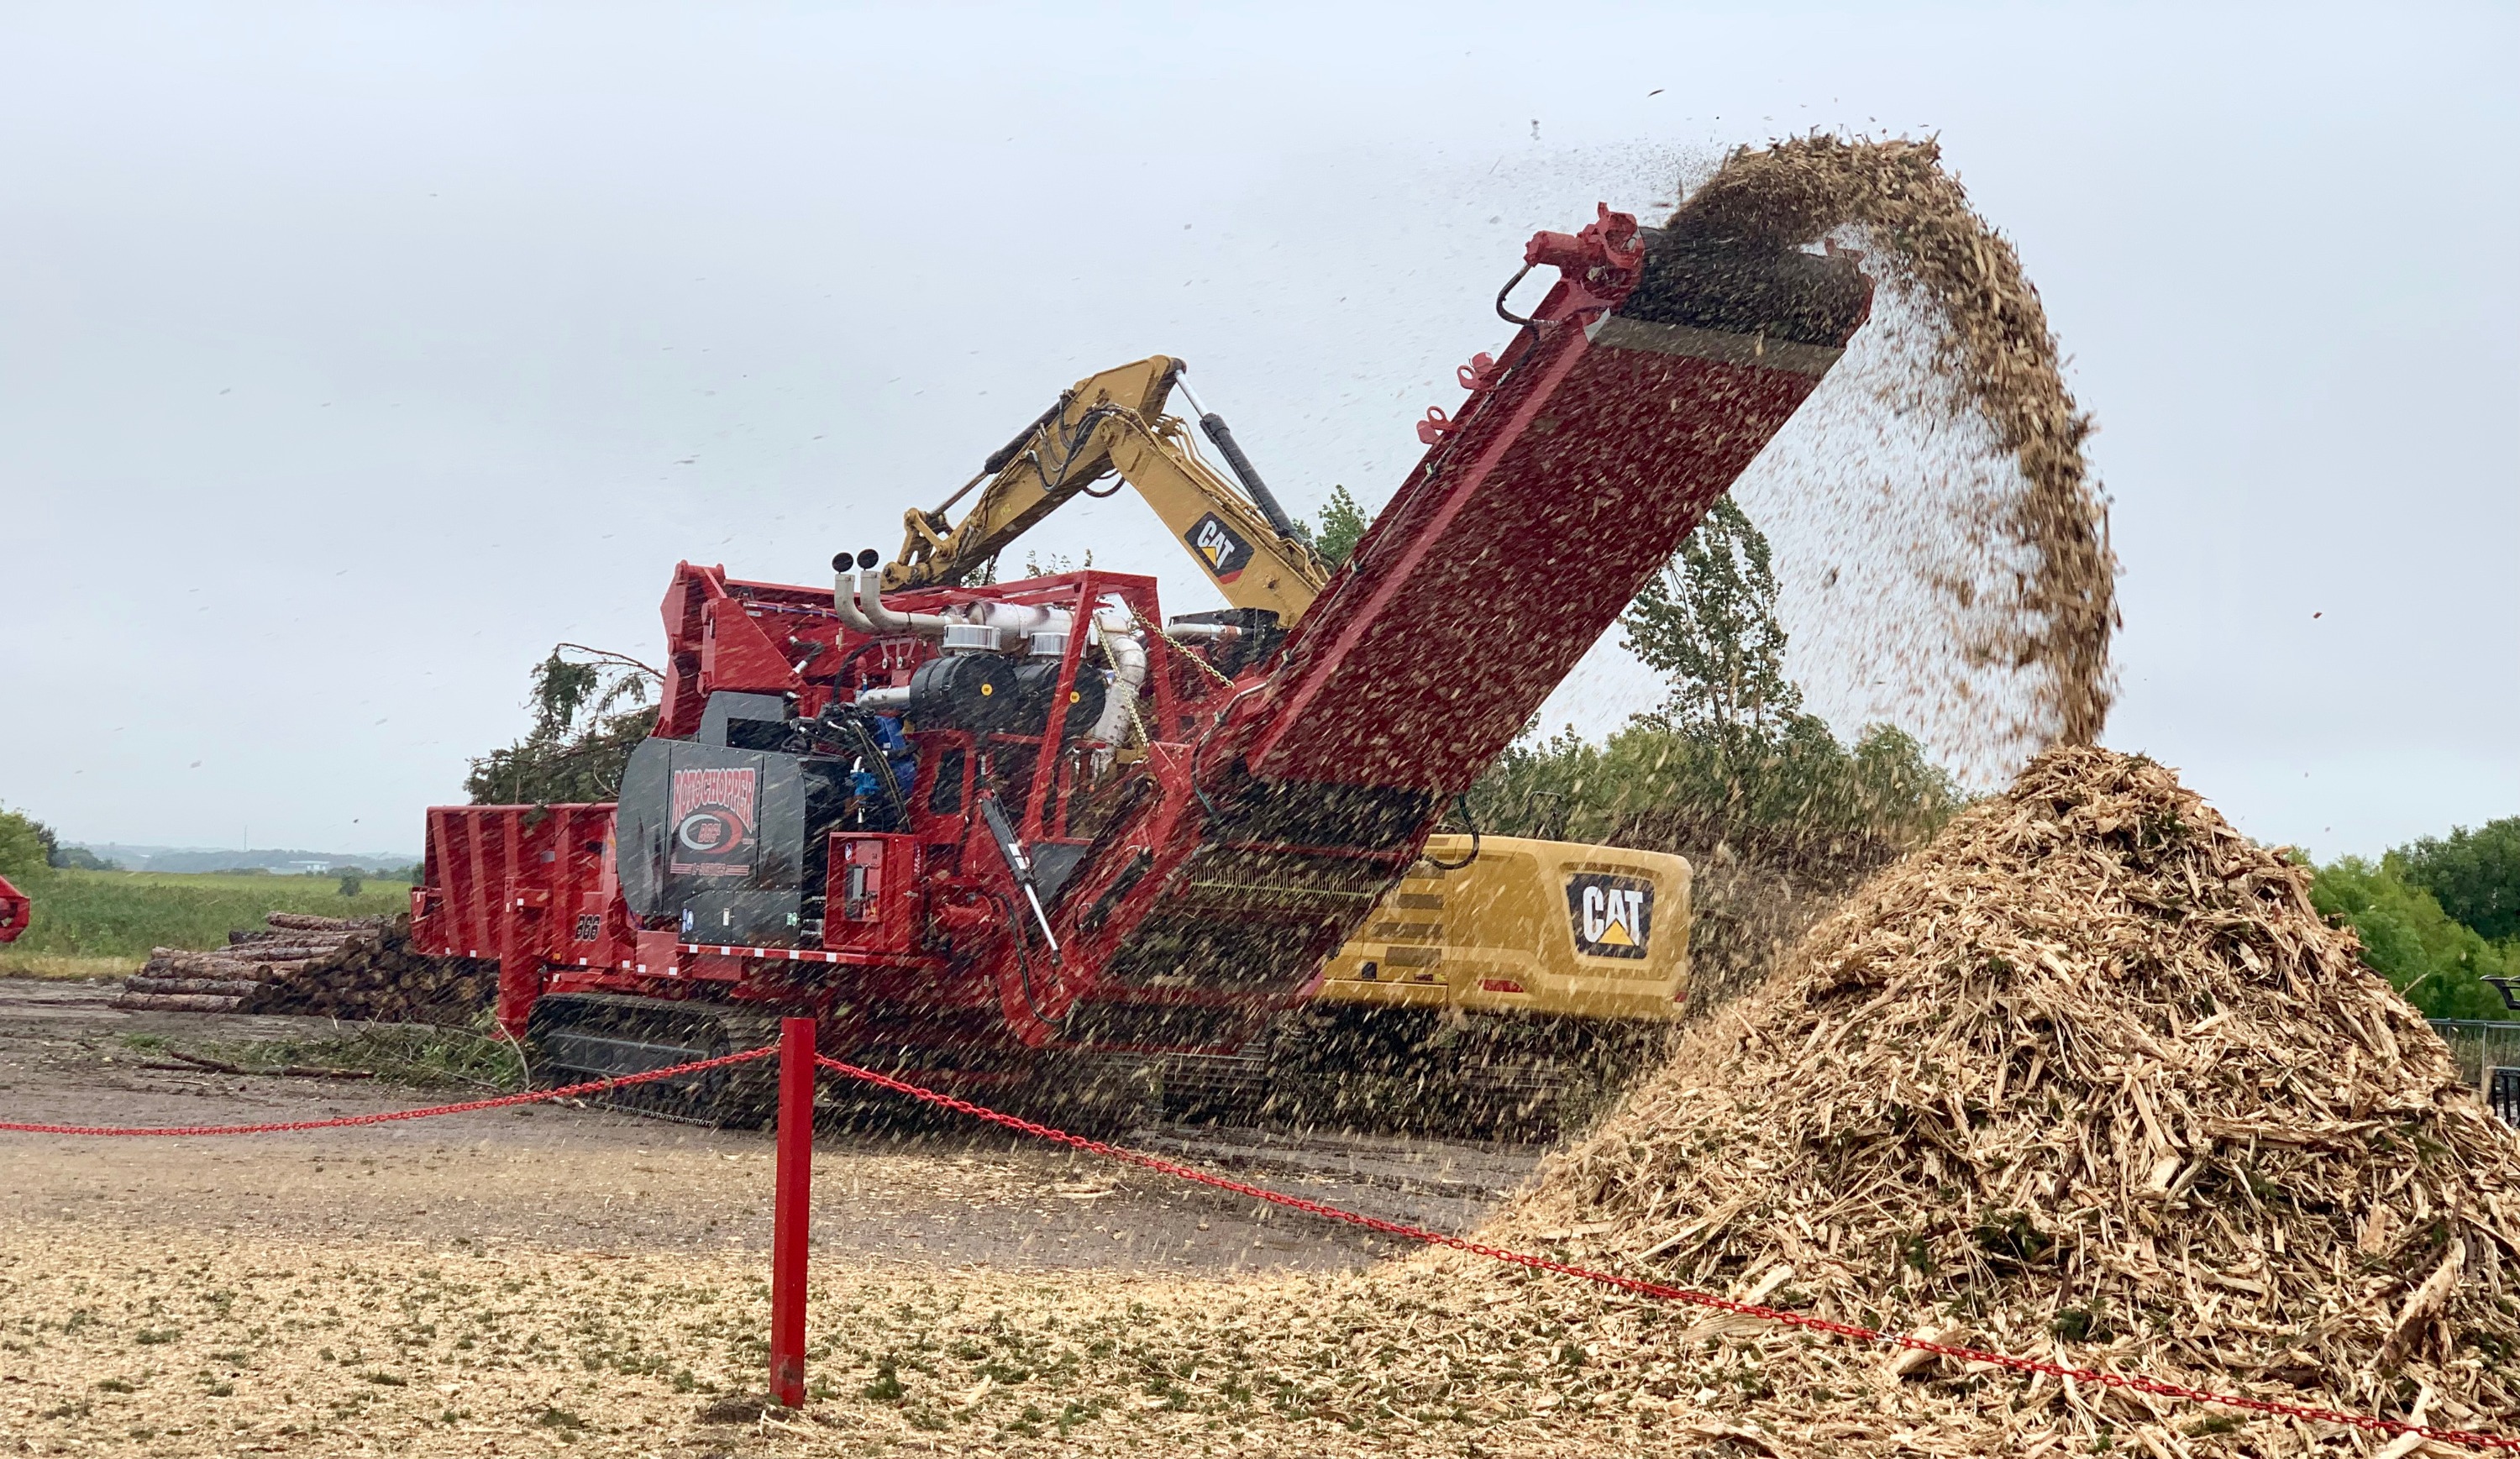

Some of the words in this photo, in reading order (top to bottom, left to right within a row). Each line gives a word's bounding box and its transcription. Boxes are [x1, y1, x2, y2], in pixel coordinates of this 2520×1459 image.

[1197, 520, 1236, 569] CAT
[671, 768, 755, 835] ROTOCHOPPER
[1583, 885, 1643, 947] CAT
